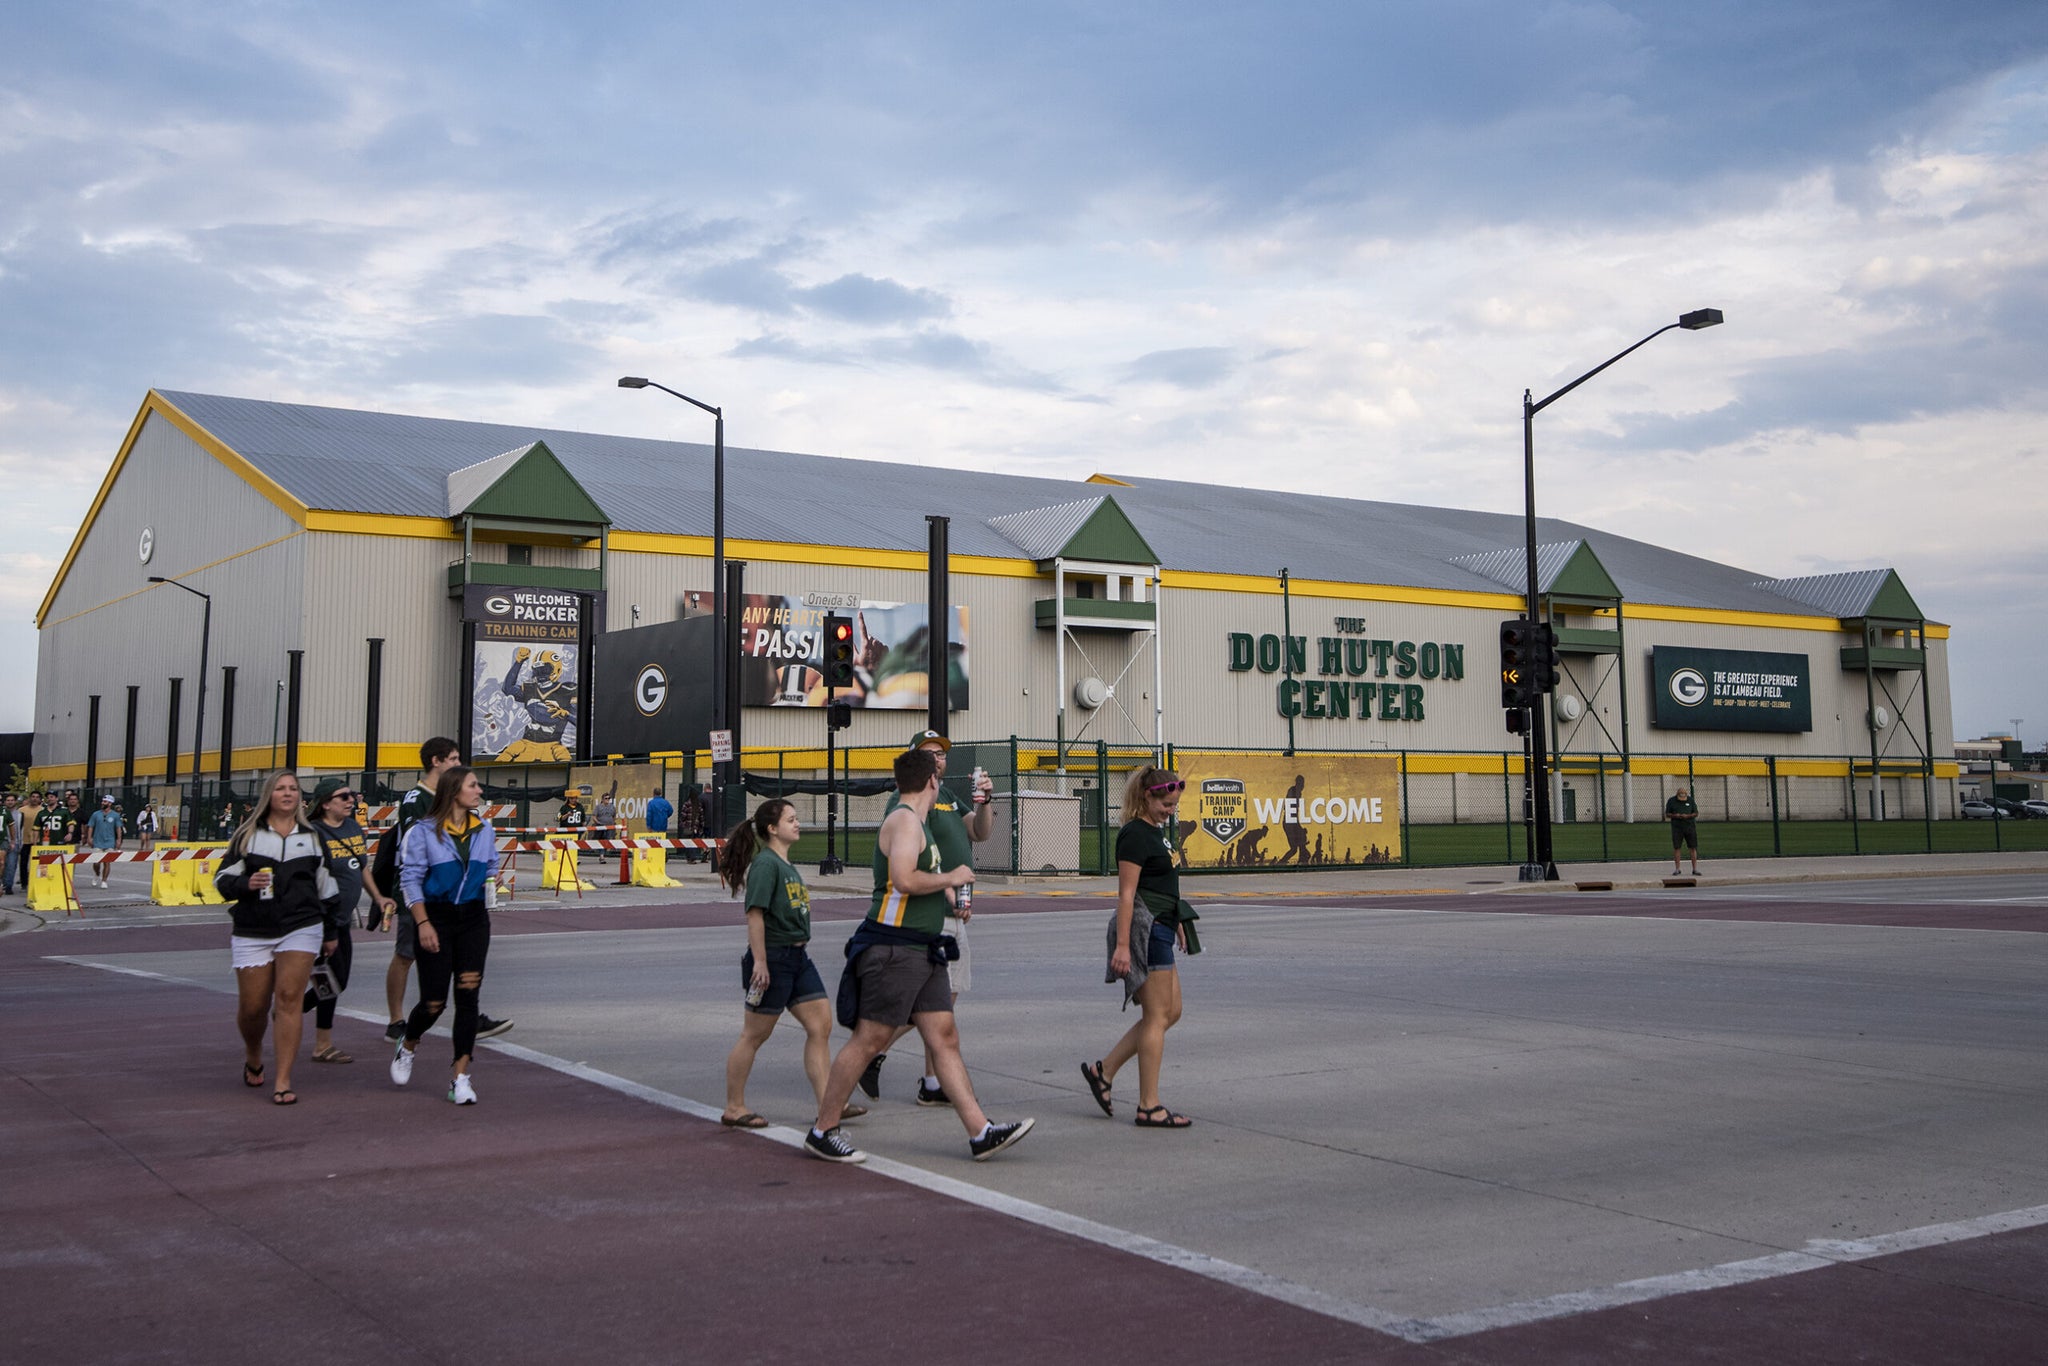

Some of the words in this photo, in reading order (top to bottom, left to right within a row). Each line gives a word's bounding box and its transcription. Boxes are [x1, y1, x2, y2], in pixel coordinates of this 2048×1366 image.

[514, 593, 571, 606] WELCOME
[573, 596, 580, 606] T
[808, 592, 842, 606] Oneida
[847, 595, 857, 607] St
[514, 605, 578, 622] PACKER
[742, 607, 771, 624] ANY
[773, 608, 825, 627] HEARTS
[485, 623, 547, 637] TRAINING
[550, 626, 577, 638] CAM
[1334, 616, 1366, 633] THE
[753, 628, 824, 660] PASSI
[1228, 632, 1307, 674] DON
[1318, 637, 1464, 680] HUTSON
[1671, 671, 1706, 704] G
[1713, 671, 1727, 683] THE
[1727, 672, 1760, 685] GREATEST
[1760, 673, 1798, 687] EXPERIENCE
[636, 668, 666, 712] G
[1713, 684, 1721, 696] IS
[1722, 685, 1731, 696] AT
[1731, 685, 1763, 698] LAMBEAU
[1278, 679, 1425, 721] CENTER
[1205, 796, 1242, 806] TRAINING
[1213, 806, 1235, 816] CAMP
[1253, 797, 1384, 825] WELCOME
